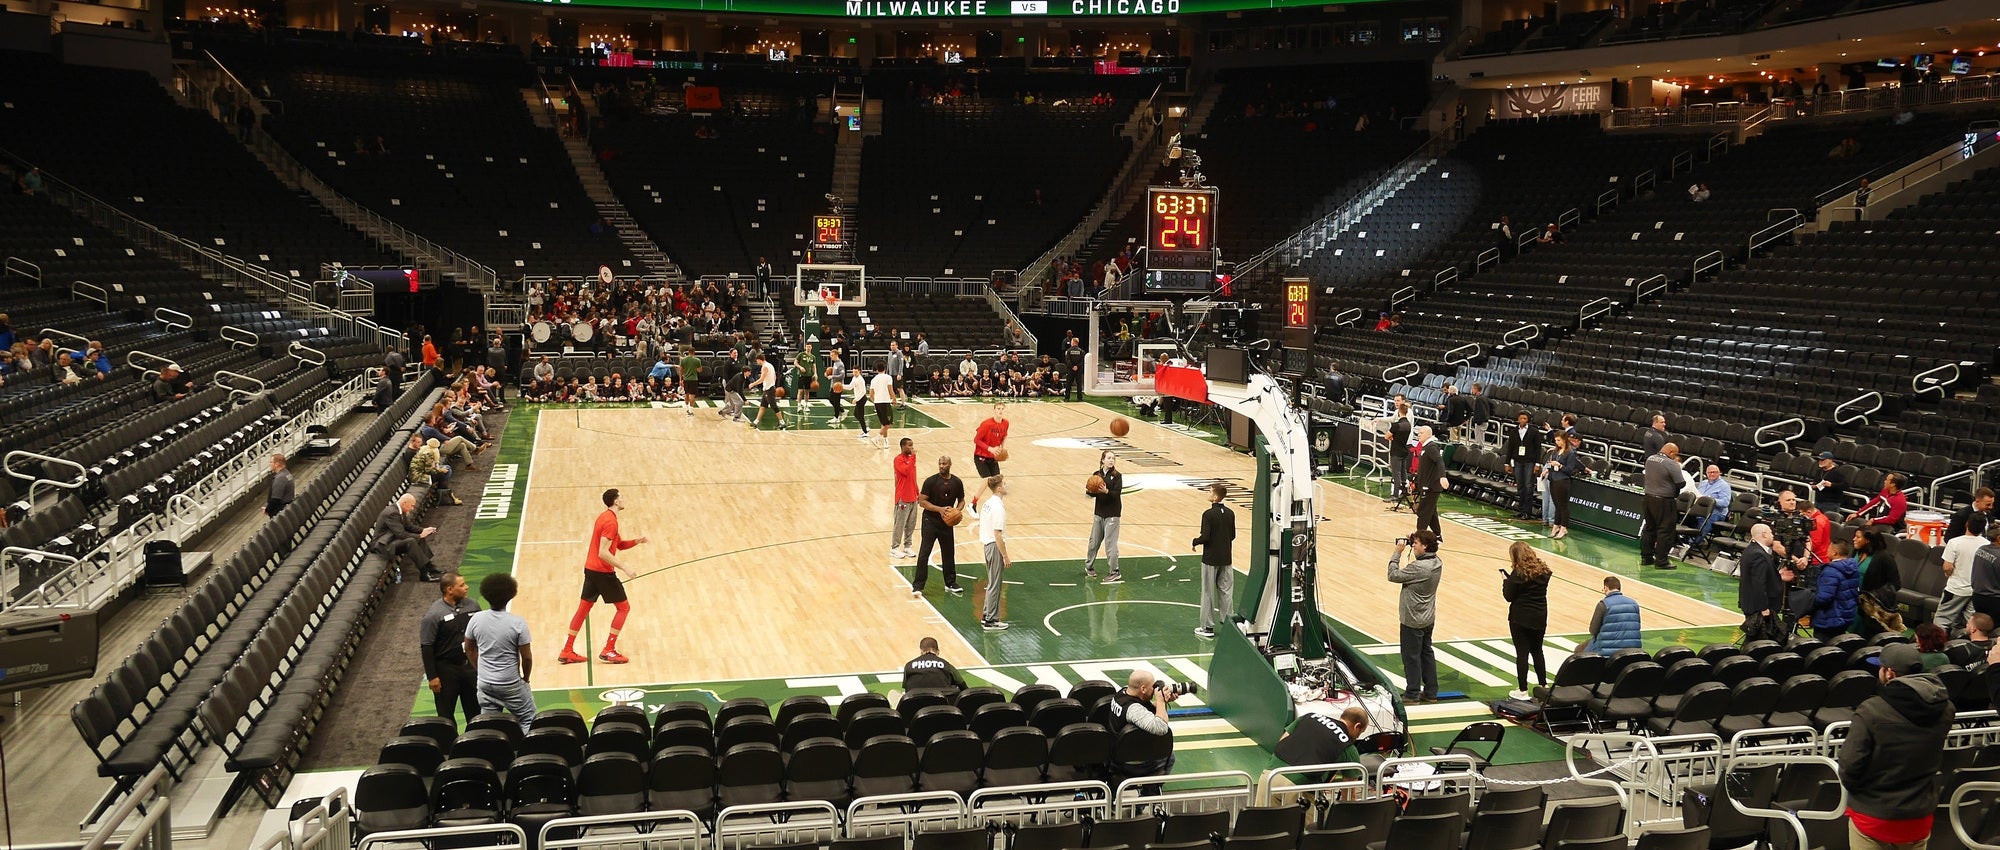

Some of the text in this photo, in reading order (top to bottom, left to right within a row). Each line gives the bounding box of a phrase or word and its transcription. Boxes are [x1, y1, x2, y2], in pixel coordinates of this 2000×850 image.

[846, 0, 1181, 16] MILWAUKEE VS CHICAGO
[1572, 86, 1600, 102] FEAR
[1156, 195, 1207, 214] 63:37
[817, 218, 841, 228] 63:37
[1161, 216, 1200, 247] 24
[819, 227, 838, 242] 24
[1291, 303, 1304, 325] 24
[1569, 496, 1600, 509] MILWAUKEE
[1615, 508, 1641, 520] CHICAGO
[911, 660, 945, 669] PHOTO
[1310, 713, 1349, 743] PHOTO
